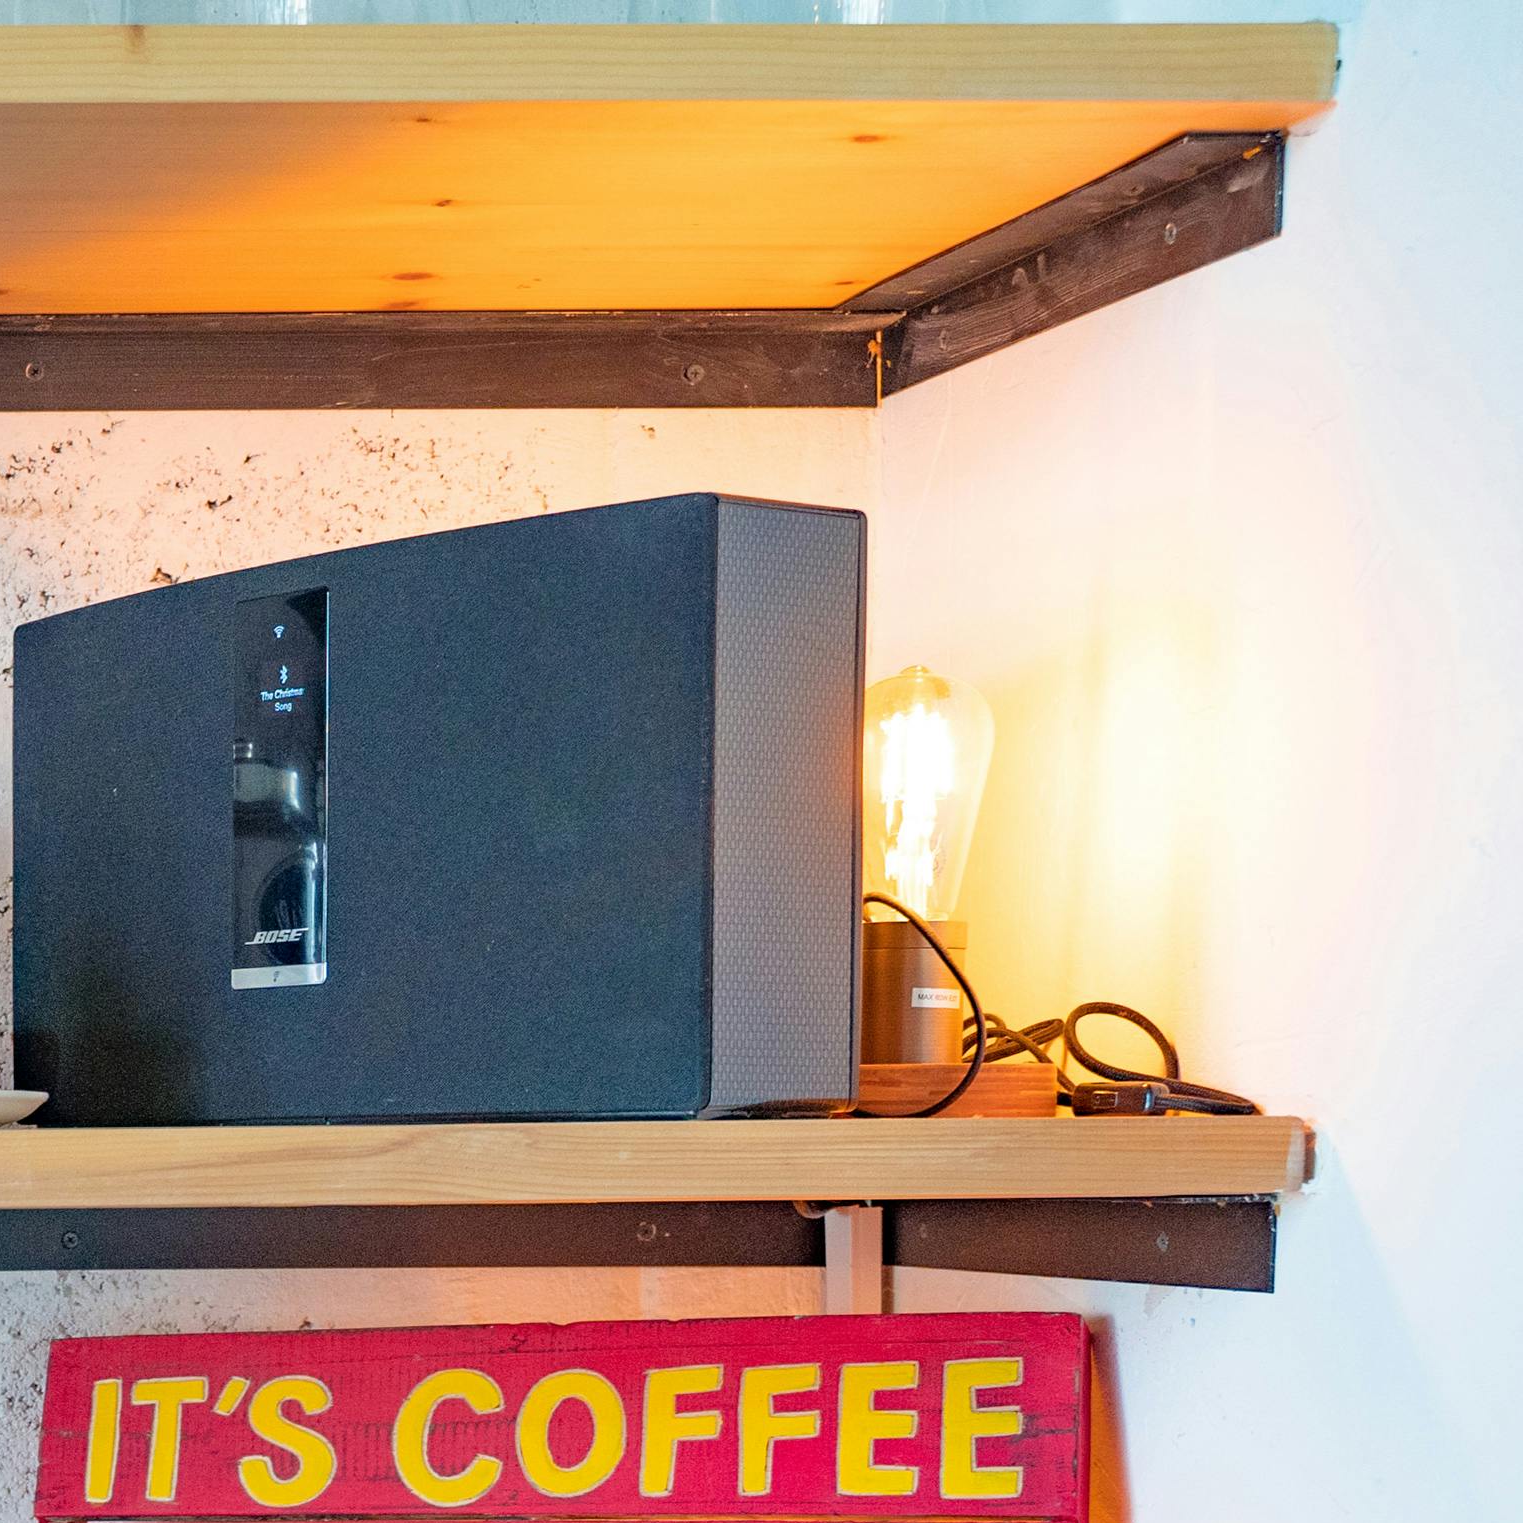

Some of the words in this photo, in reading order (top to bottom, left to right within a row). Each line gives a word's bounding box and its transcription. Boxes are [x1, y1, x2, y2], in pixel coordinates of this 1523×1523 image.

[260, 691, 273, 702] The
[274, 702, 292, 712] Song
[244, 927, 309, 945] BOSE
[86, 1373, 335, 1507] IT'S
[393, 1357, 1024, 1507] COFFEE
